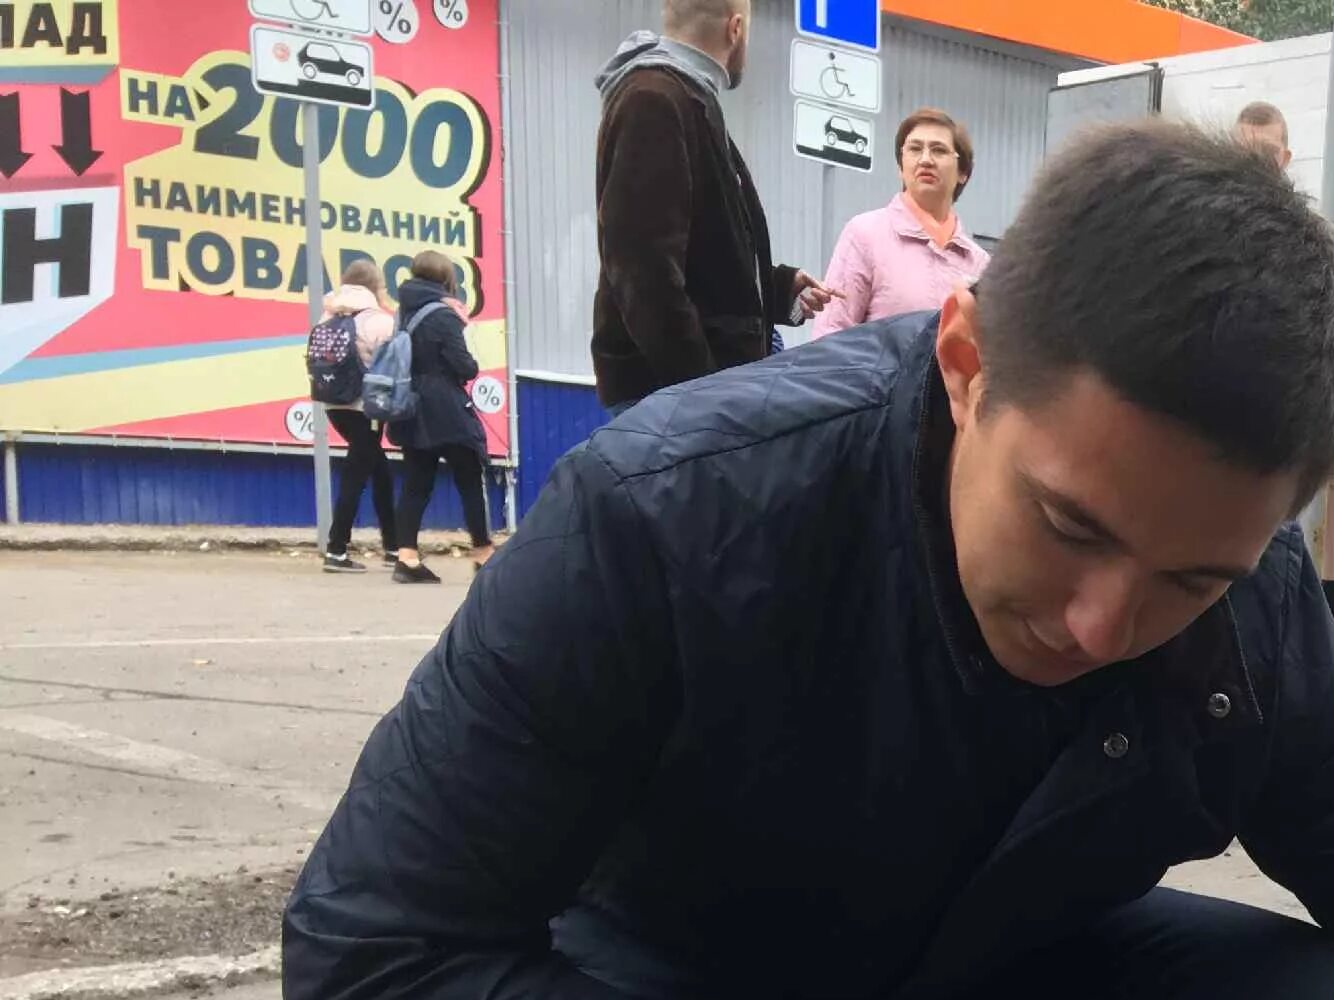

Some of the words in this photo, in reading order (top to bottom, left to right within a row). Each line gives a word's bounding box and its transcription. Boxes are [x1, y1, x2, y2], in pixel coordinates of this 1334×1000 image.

[128, 77, 196, 121] НА
[193, 63, 473, 188] 2000
[134, 176, 466, 247] НАИМЕНОВАНИЙ
